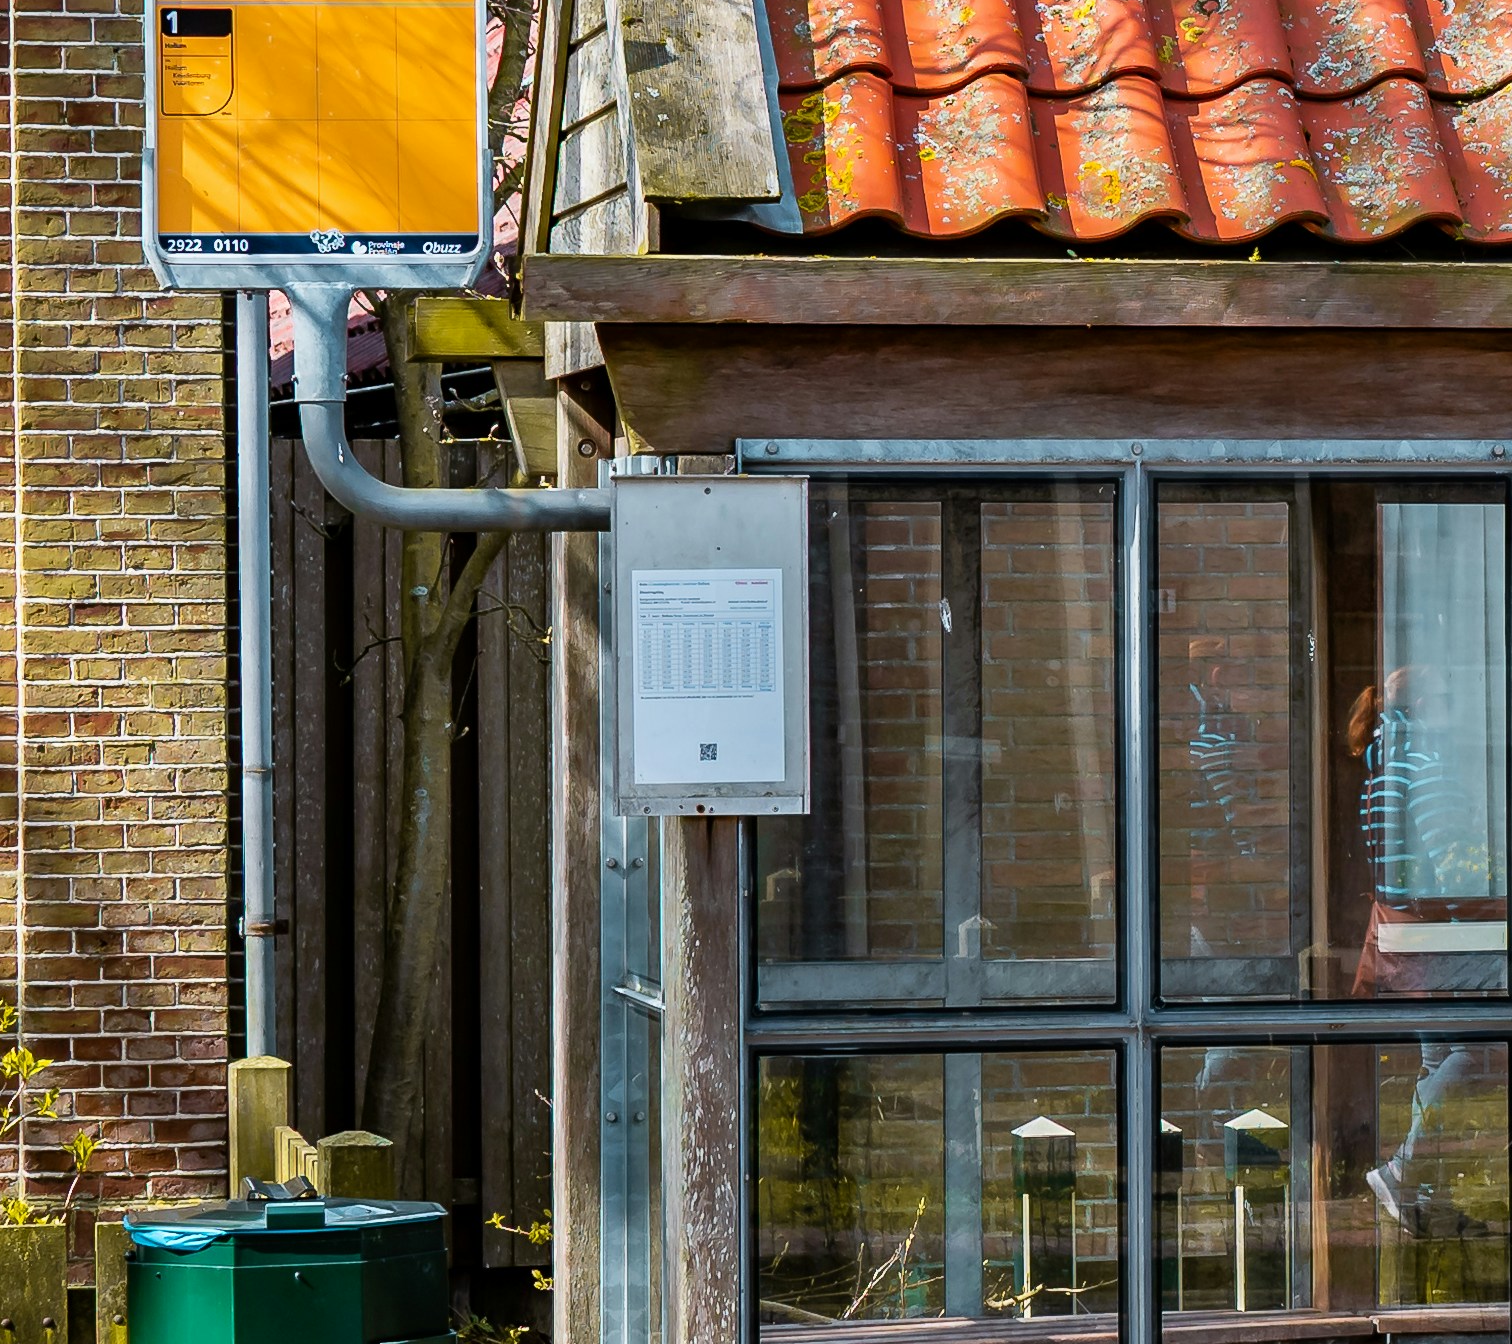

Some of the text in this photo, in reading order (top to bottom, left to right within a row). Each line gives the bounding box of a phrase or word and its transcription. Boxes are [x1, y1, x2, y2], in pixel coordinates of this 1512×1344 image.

[166, 10, 178, 34] 1
[167, 238, 249, 252] 2922 0110
[422, 241, 462, 255] Qbuzz
